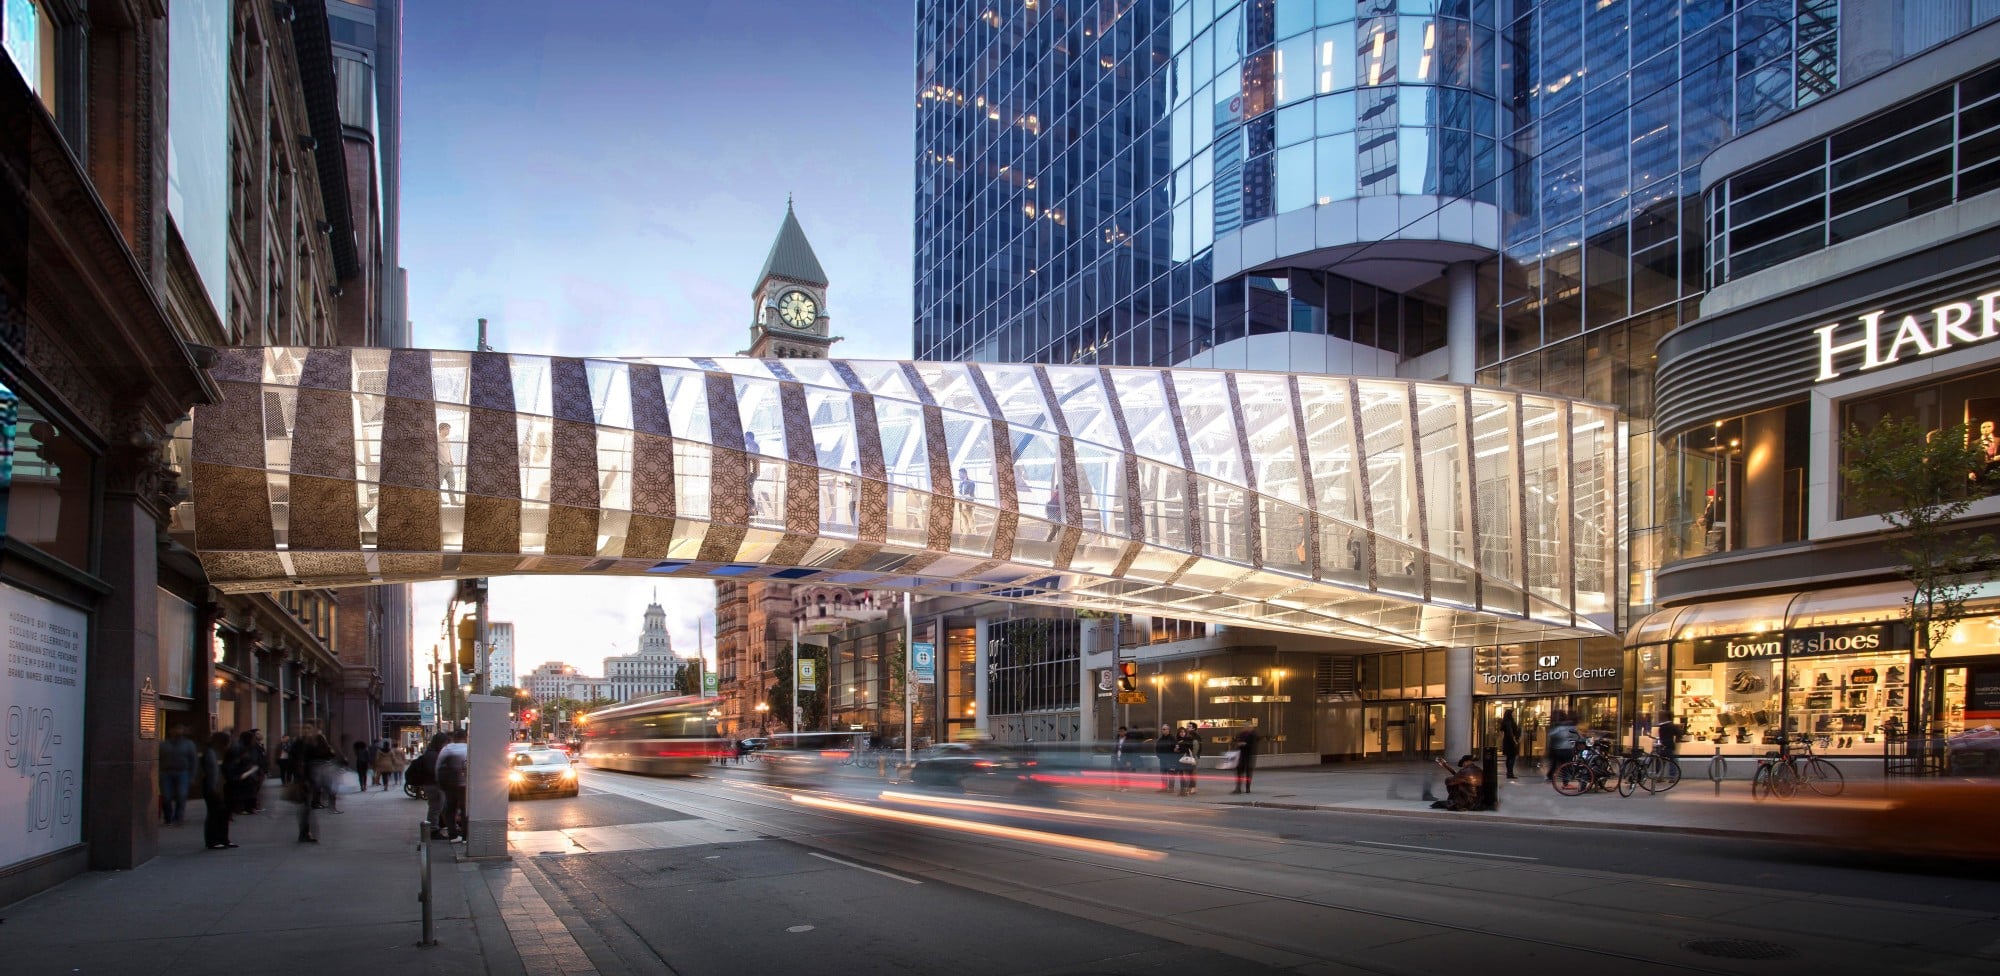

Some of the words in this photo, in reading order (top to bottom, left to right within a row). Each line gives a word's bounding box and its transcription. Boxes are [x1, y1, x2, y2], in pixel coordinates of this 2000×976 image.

[1726, 640, 1783, 658] town
[1807, 631, 1880, 653] shoes
[1539, 655, 1560, 667] CF
[1482, 671, 1530, 684] Toronto
[1534, 669, 1569, 682] Eaton
[1573, 666, 1616, 679] Centre
[5, 705, 62, 778] 9/12-
[27, 769, 73, 838] 10/6
